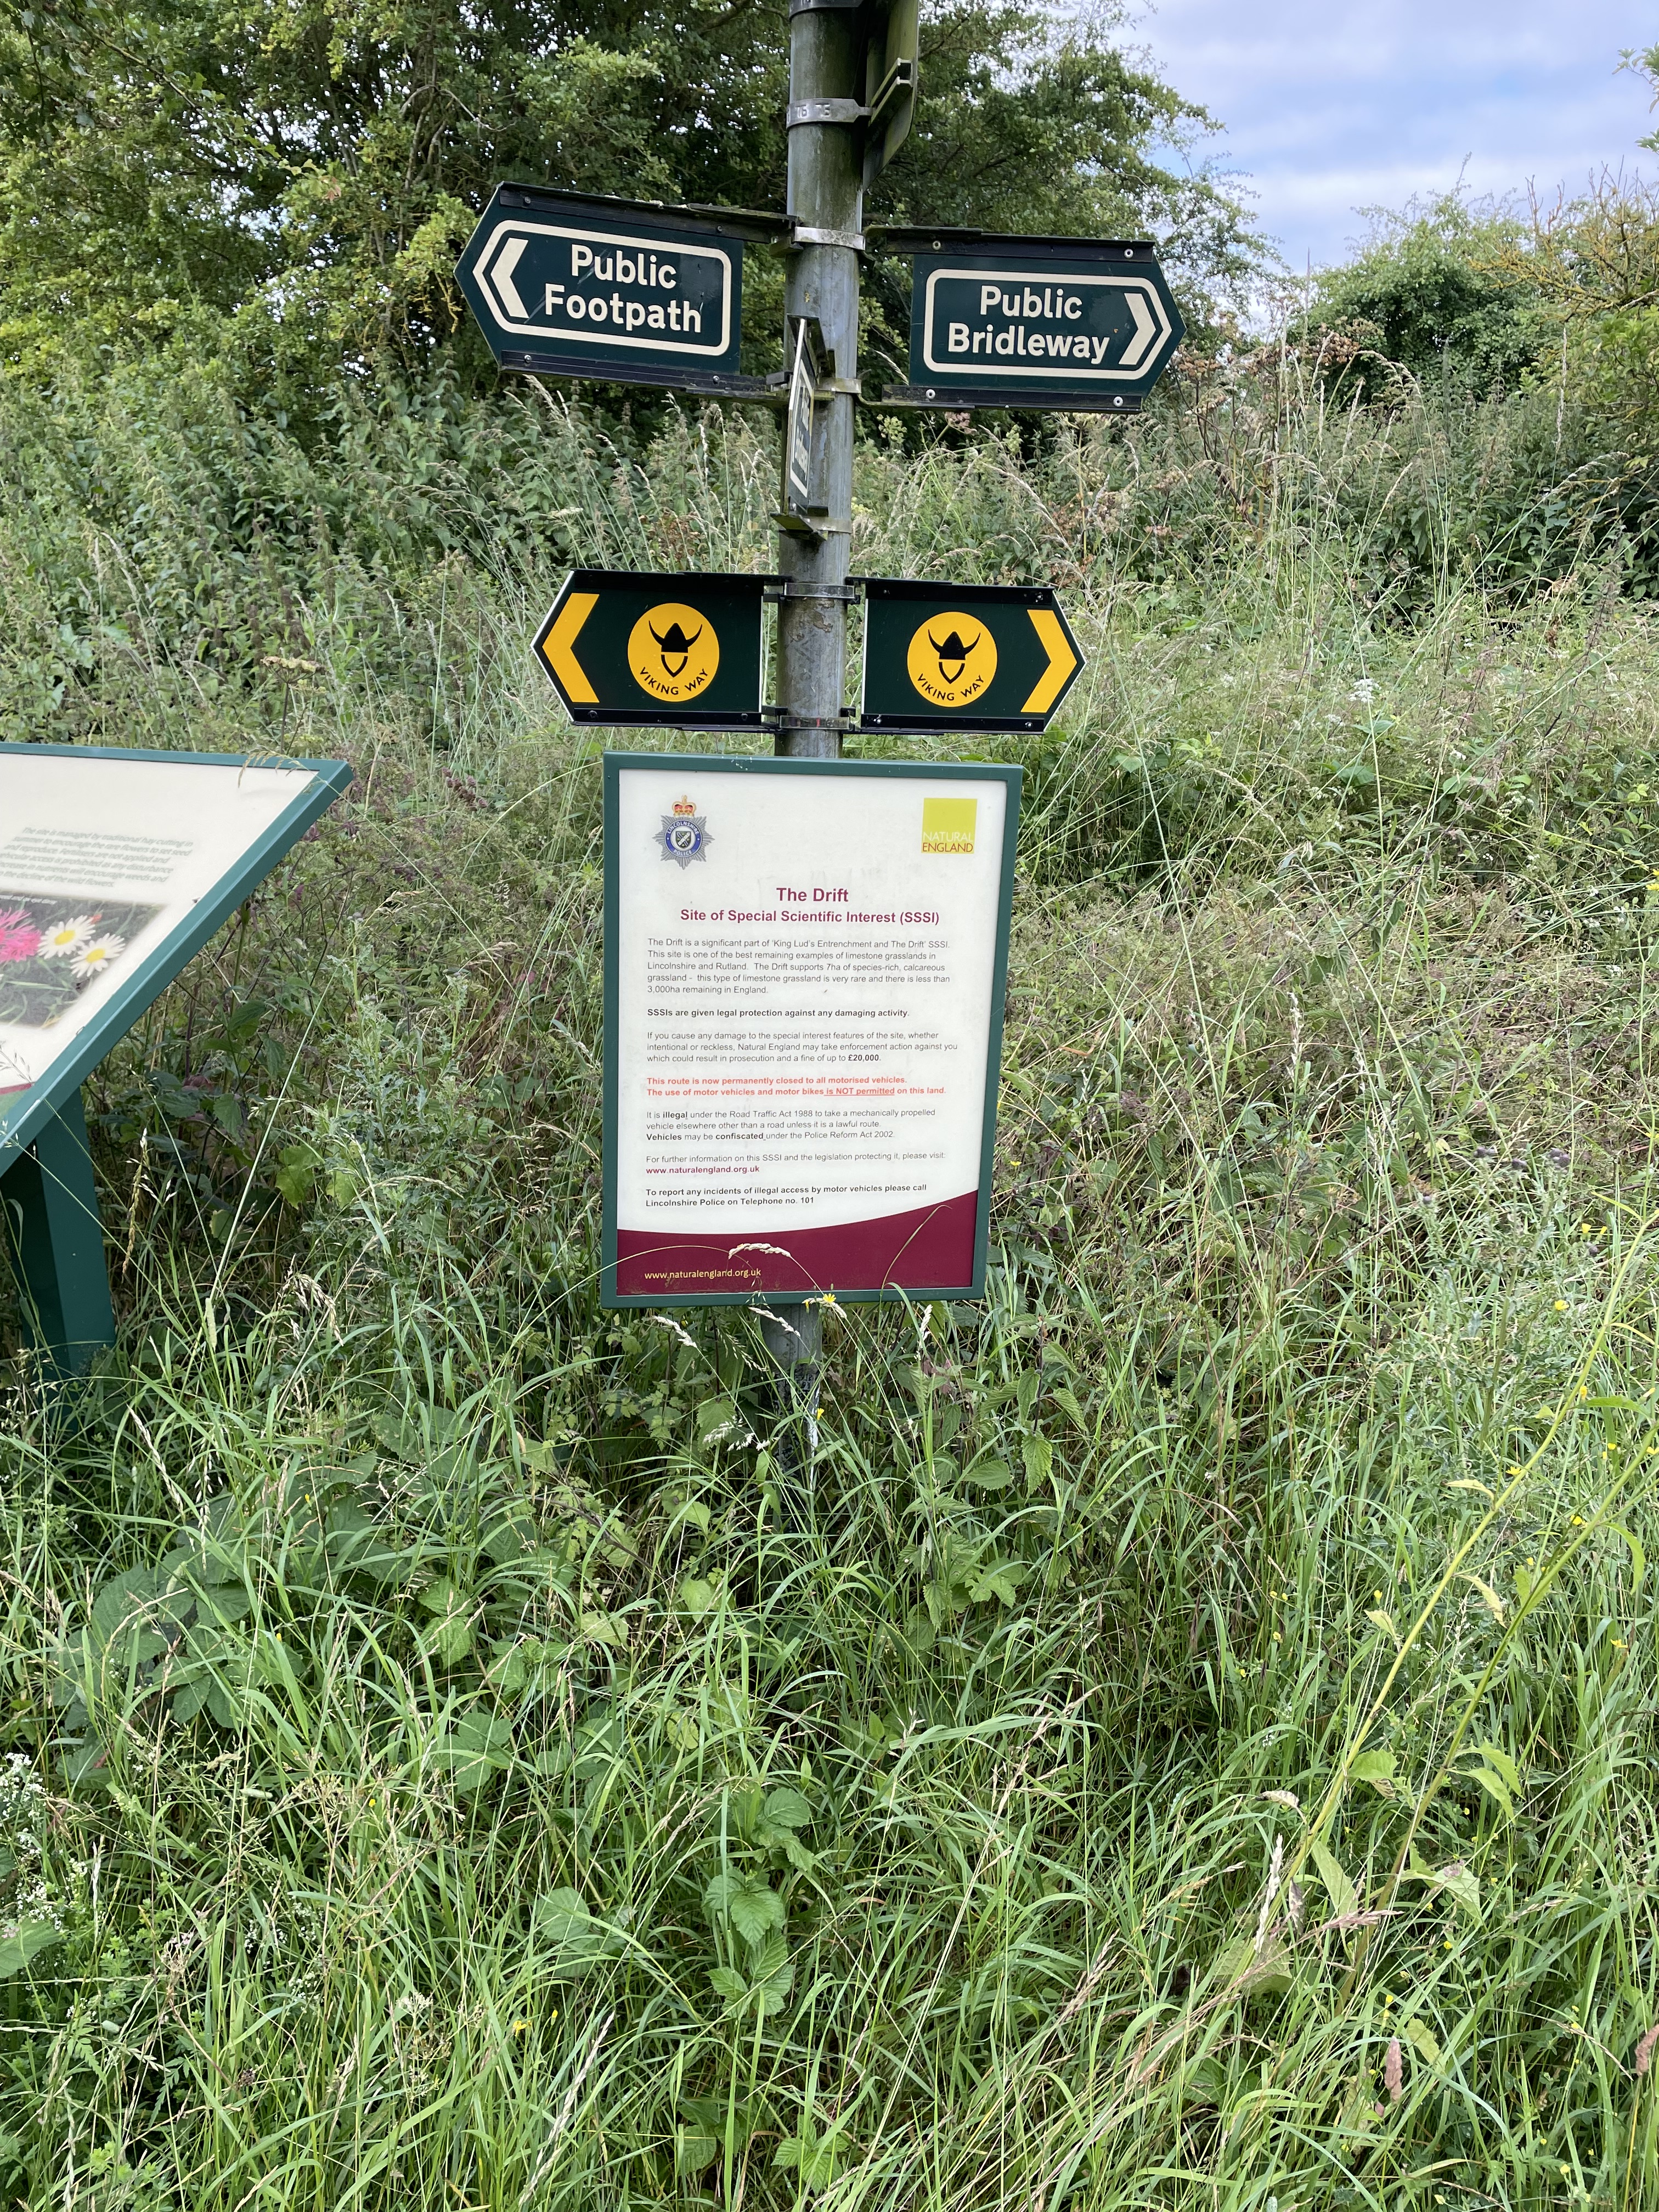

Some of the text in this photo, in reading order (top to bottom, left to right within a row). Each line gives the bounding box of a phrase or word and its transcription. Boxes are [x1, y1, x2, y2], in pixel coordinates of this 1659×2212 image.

[571, 244, 676, 289] Public
[545, 283, 701, 332] Footpath
[980, 285, 1082, 319] Public
[948, 322, 1110, 365] Bridleway
[640, 667, 708, 695] VIKING WAY
[917, 673, 984, 701] VIKING WAY
[667, 820, 699, 834] LINCOLNSHIRE
[923, 832, 973, 842] NATURAL
[922, 842, 973, 853] ENGLAND
[776, 888, 848, 902] The Drift
[681, 909, 939, 926] Site of Special Scientific Interest (SSSI)
[666, 938, 683, 946] Drift
[685, 938, 692, 946] is
[701, 939, 742, 948] significant
[744, 940, 760, 949] part
[794, 939, 815, 947] Lud's
[817, 940, 872, 948] Entrenchment
[647, 950, 665, 958] This
[710, 950, 719, 958] of
[754, 952, 794, 961] remaining
[795, 951, 834, 961] examples
[836, 951, 844, 960] of
[845, 951, 883, 960] limestone
[884, 952, 927, 961] grasslands
[647, 962, 696, 970] Lincolnshire
[753, 962, 769, 970] The
[789, 963, 824, 972] supports
[826, 963, 840, 971] 7ha
[843, 963, 851, 971] of
[853, 963, 901, 973] species-rich,
[691, 1008, 714, 1018] given
[716, 1009, 737, 1018] legal
[740, 1009, 782, 1018] protection
[785, 1009, 816, 1018] against
[834, 1009, 876, 1018] damaging
[878, 1009, 910, 1018] activity.
[729, 1054, 775, 1064] prosecution
[848, 1054, 882, 1063] £20,000.
[721, 1077, 774, 1086] permanently
[856, 1087, 895, 1097] permitted
[645, 1165, 760, 1175] www.naturalengland.org.uk
[659, 1188, 685, 1197] report
[754, 1187, 778, 1195] illegal
[811, 1186, 822, 1194] by
[884, 1184, 911, 1193] please
[646, 1199, 698, 1207] Lincolnshire
[740, 1198, 783, 1206] Telephone
[644, 1268, 761, 1279] www.naturalengland.org.uk
